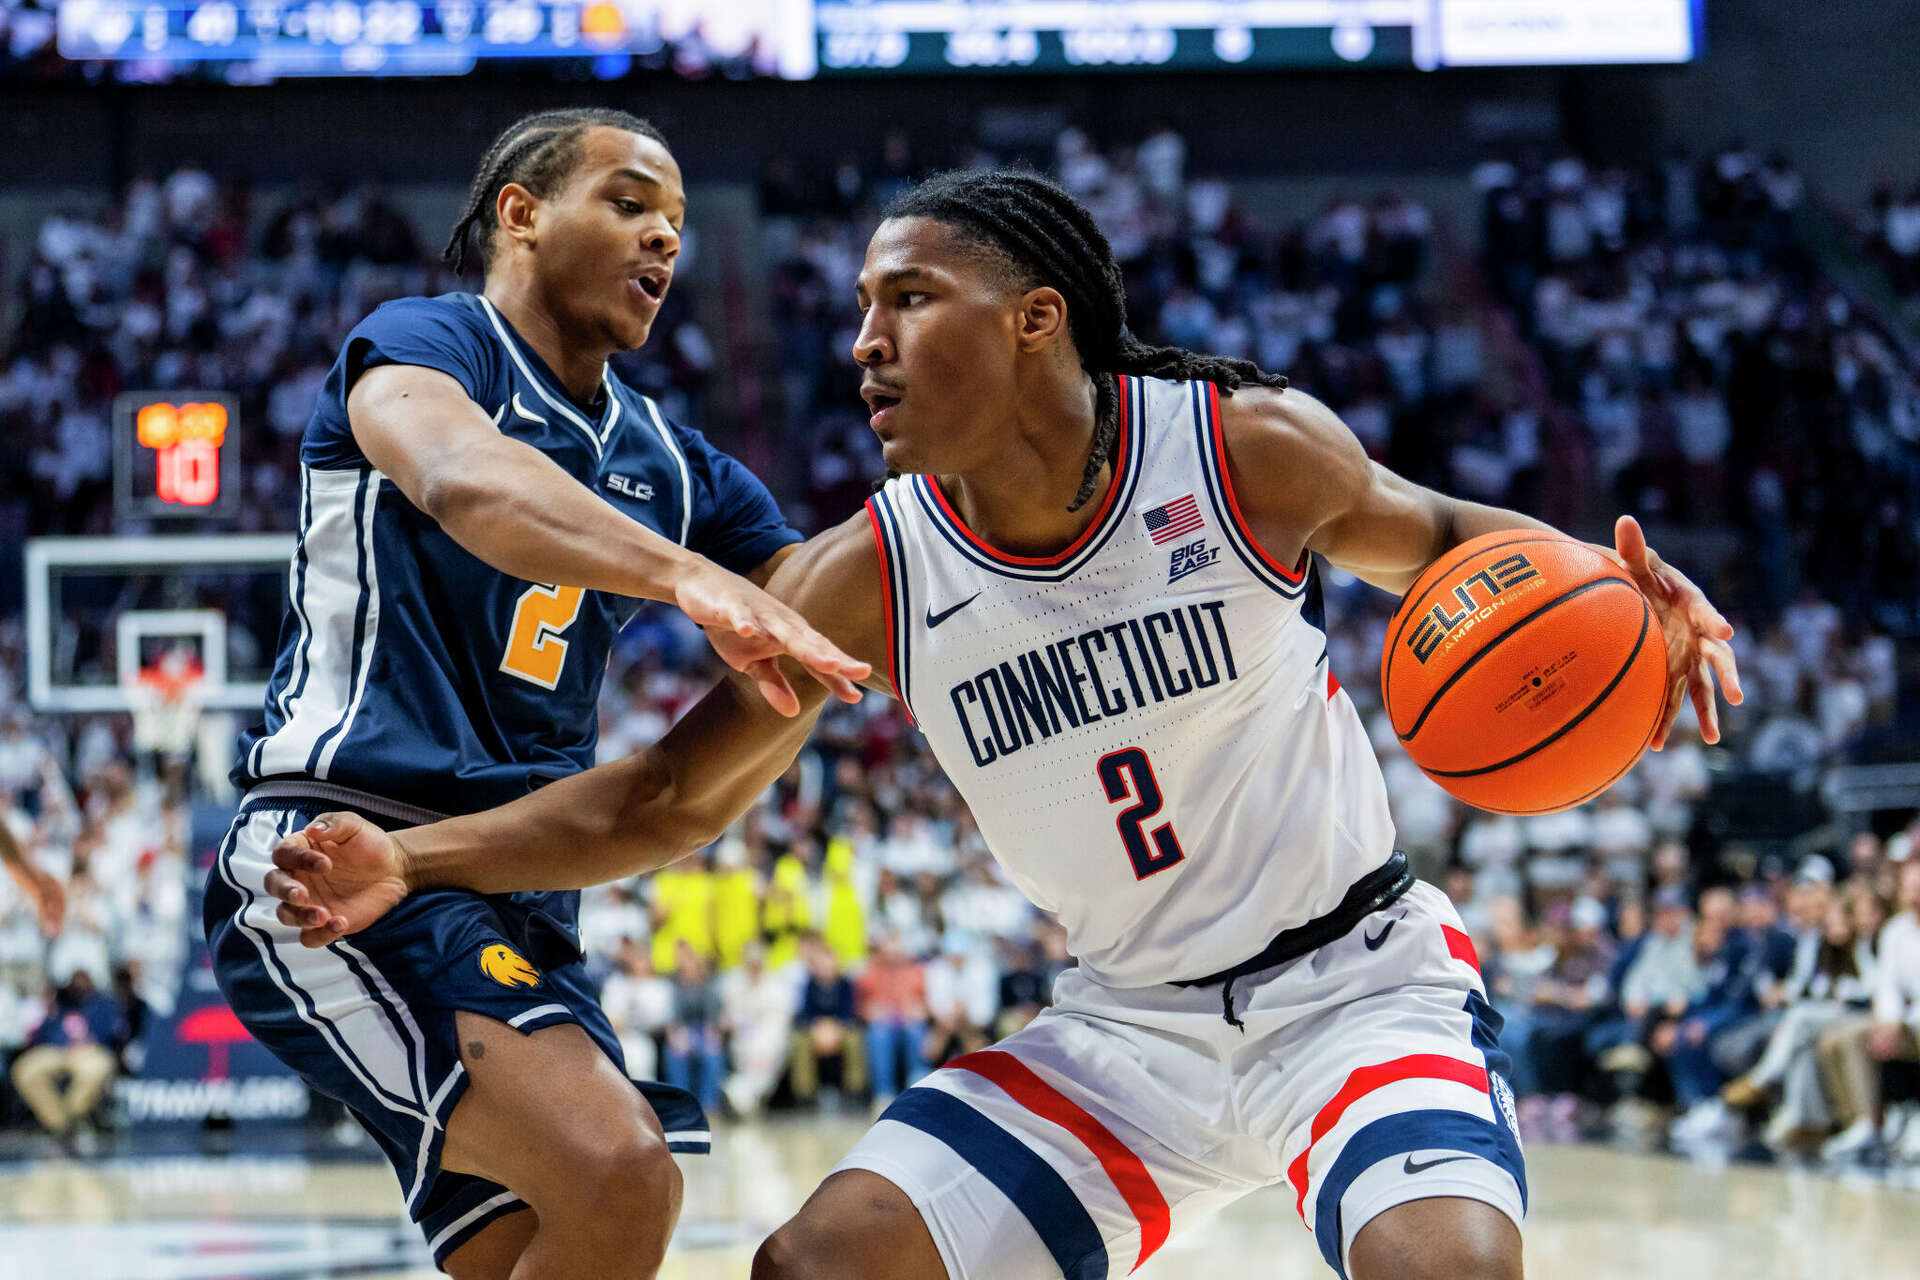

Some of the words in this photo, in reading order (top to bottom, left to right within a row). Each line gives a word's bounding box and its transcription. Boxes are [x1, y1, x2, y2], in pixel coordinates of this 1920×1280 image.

[1169, 547, 1220, 577] EAST
[1170, 538, 1206, 564] BIG
[498, 583, 586, 691] 2
[1430, 577, 1547, 667] AMPIONSHIP
[950, 600, 1238, 768] CONNECTICUT
[1096, 746, 1185, 881] 2
